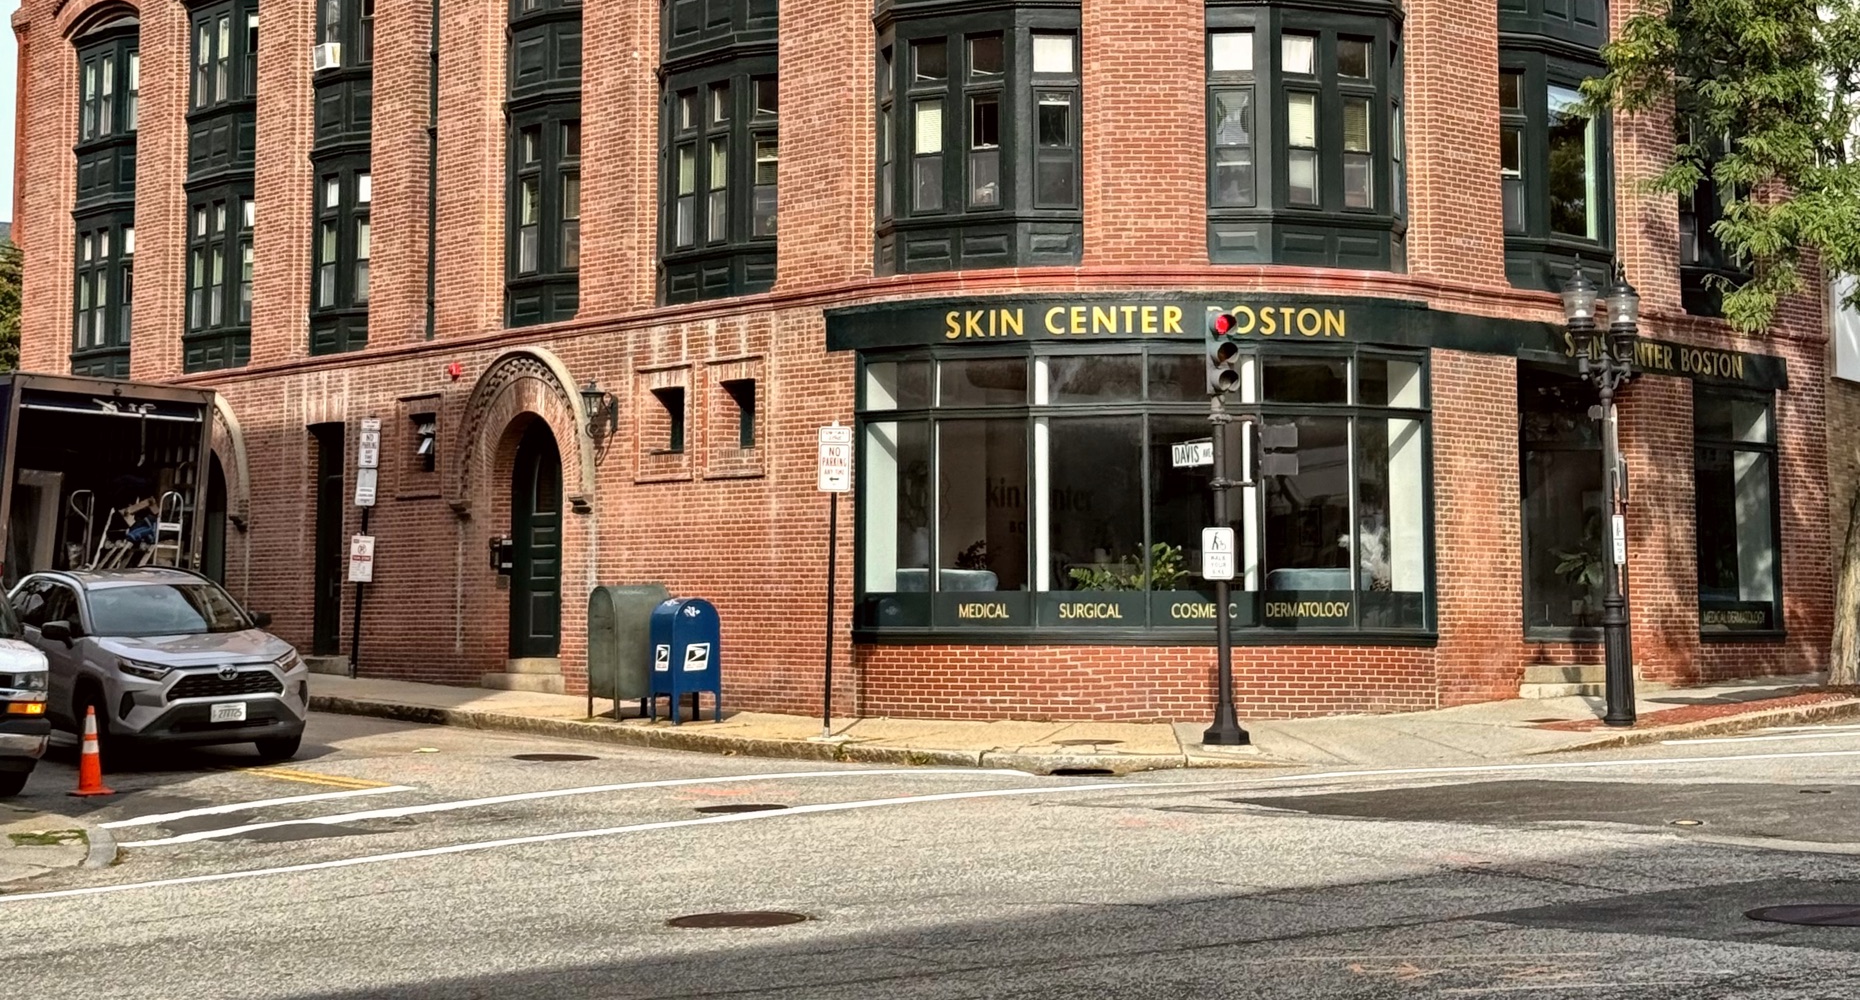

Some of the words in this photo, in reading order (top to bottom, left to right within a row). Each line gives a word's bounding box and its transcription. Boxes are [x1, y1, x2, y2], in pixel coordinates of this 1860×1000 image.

[945, 308, 1024, 339] SKIN
[1045, 305, 1183, 335] CENTER
[1207, 305, 1346, 337] OSTON
[1564, 331, 1605, 360] SIN
[1681, 348, 1744, 380] BOSTON
[829, 447, 841, 456] NO
[1174, 445, 1200, 464] DAVIS
[822, 458, 847, 467] PARKING
[958, 603, 1010, 619] MEDICAL
[1059, 603, 1123, 619] SURGICAL
[1171, 603, 1238, 619] COSMEC
[1265, 602, 1350, 618] DERMATOLOGY
